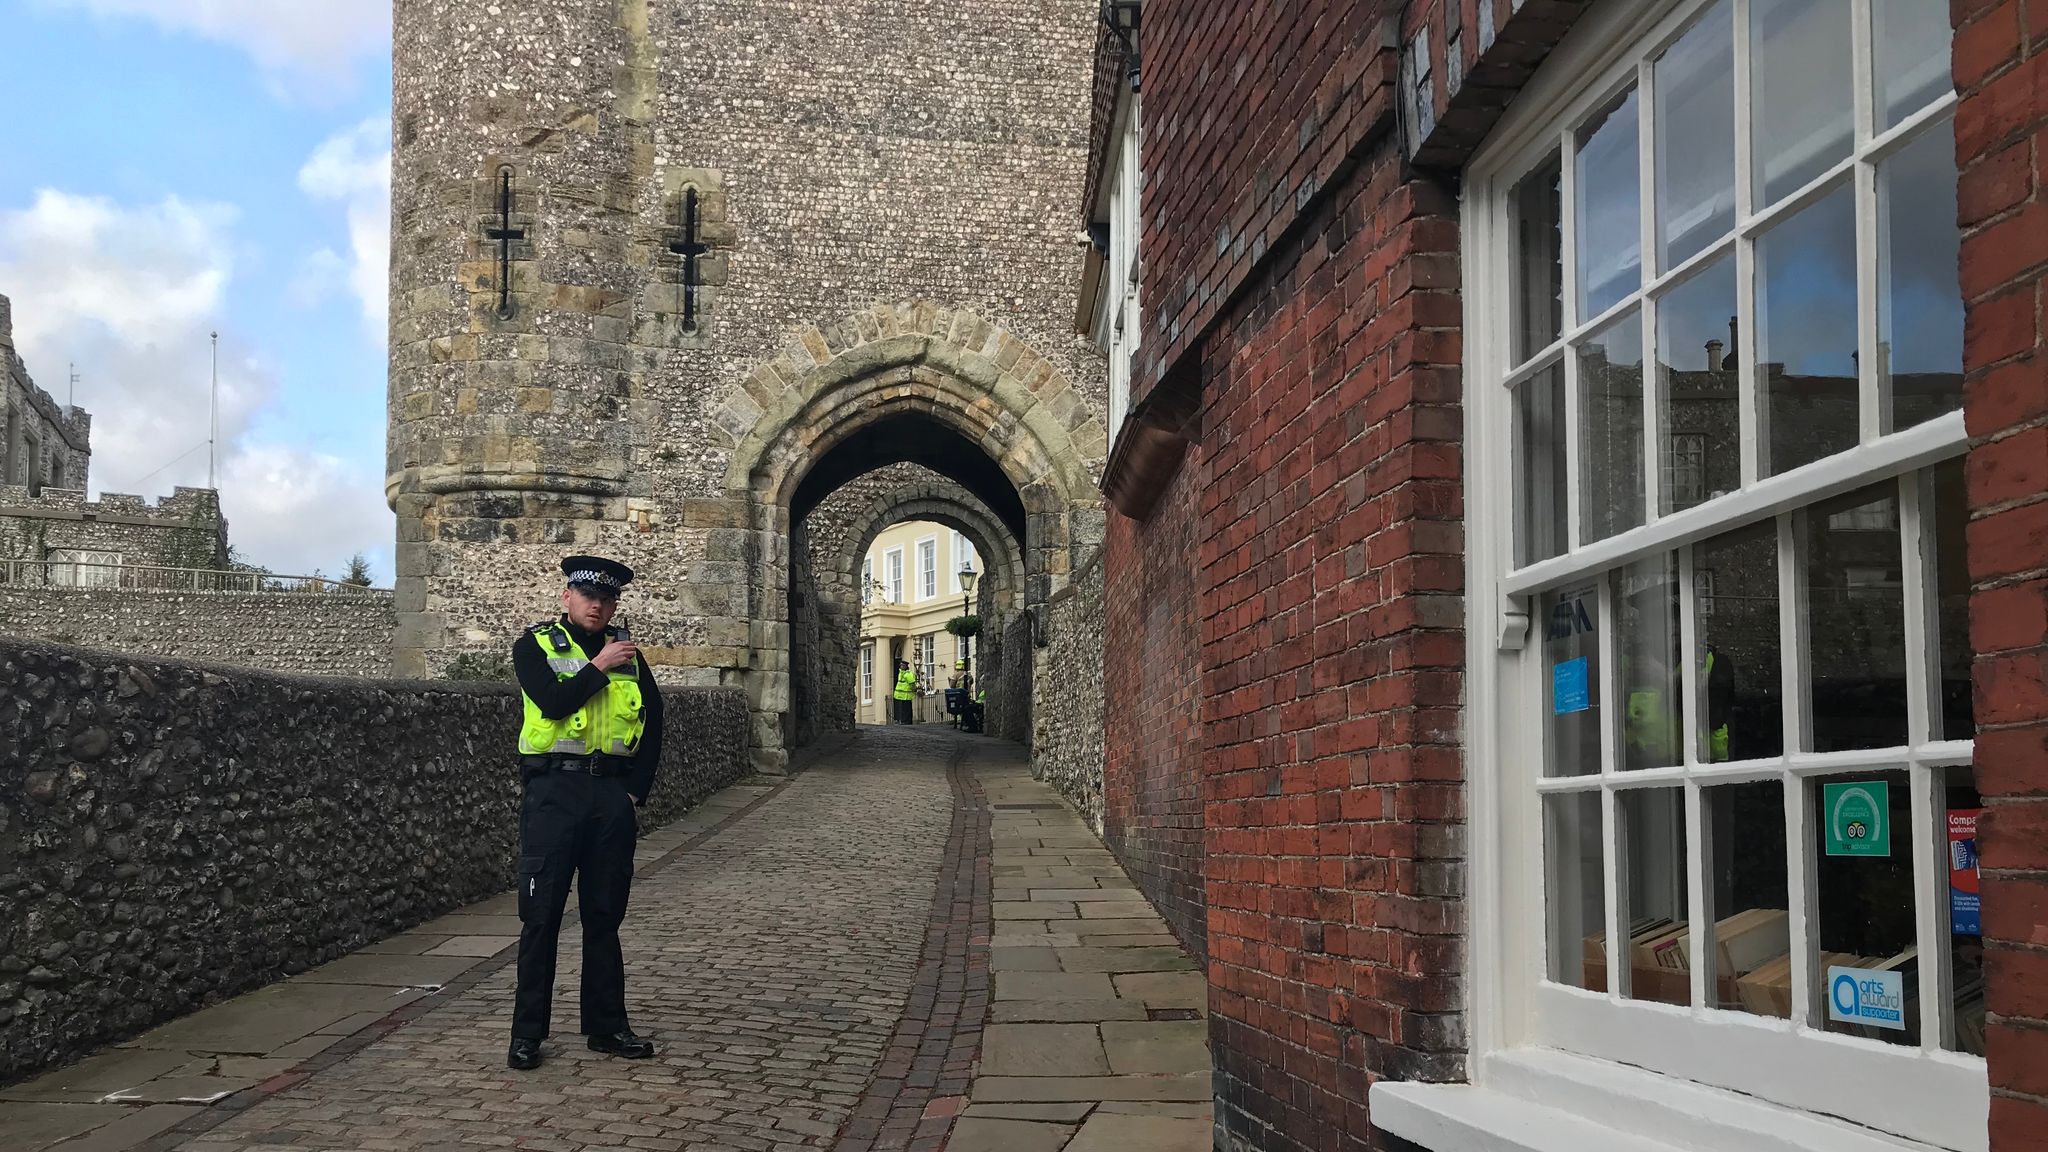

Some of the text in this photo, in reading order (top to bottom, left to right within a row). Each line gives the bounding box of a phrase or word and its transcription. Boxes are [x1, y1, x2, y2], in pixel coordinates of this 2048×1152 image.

[1860, 979, 1884, 995] arts
[1861, 992, 1899, 1009] award
[1862, 1007, 1898, 1019] supporter
